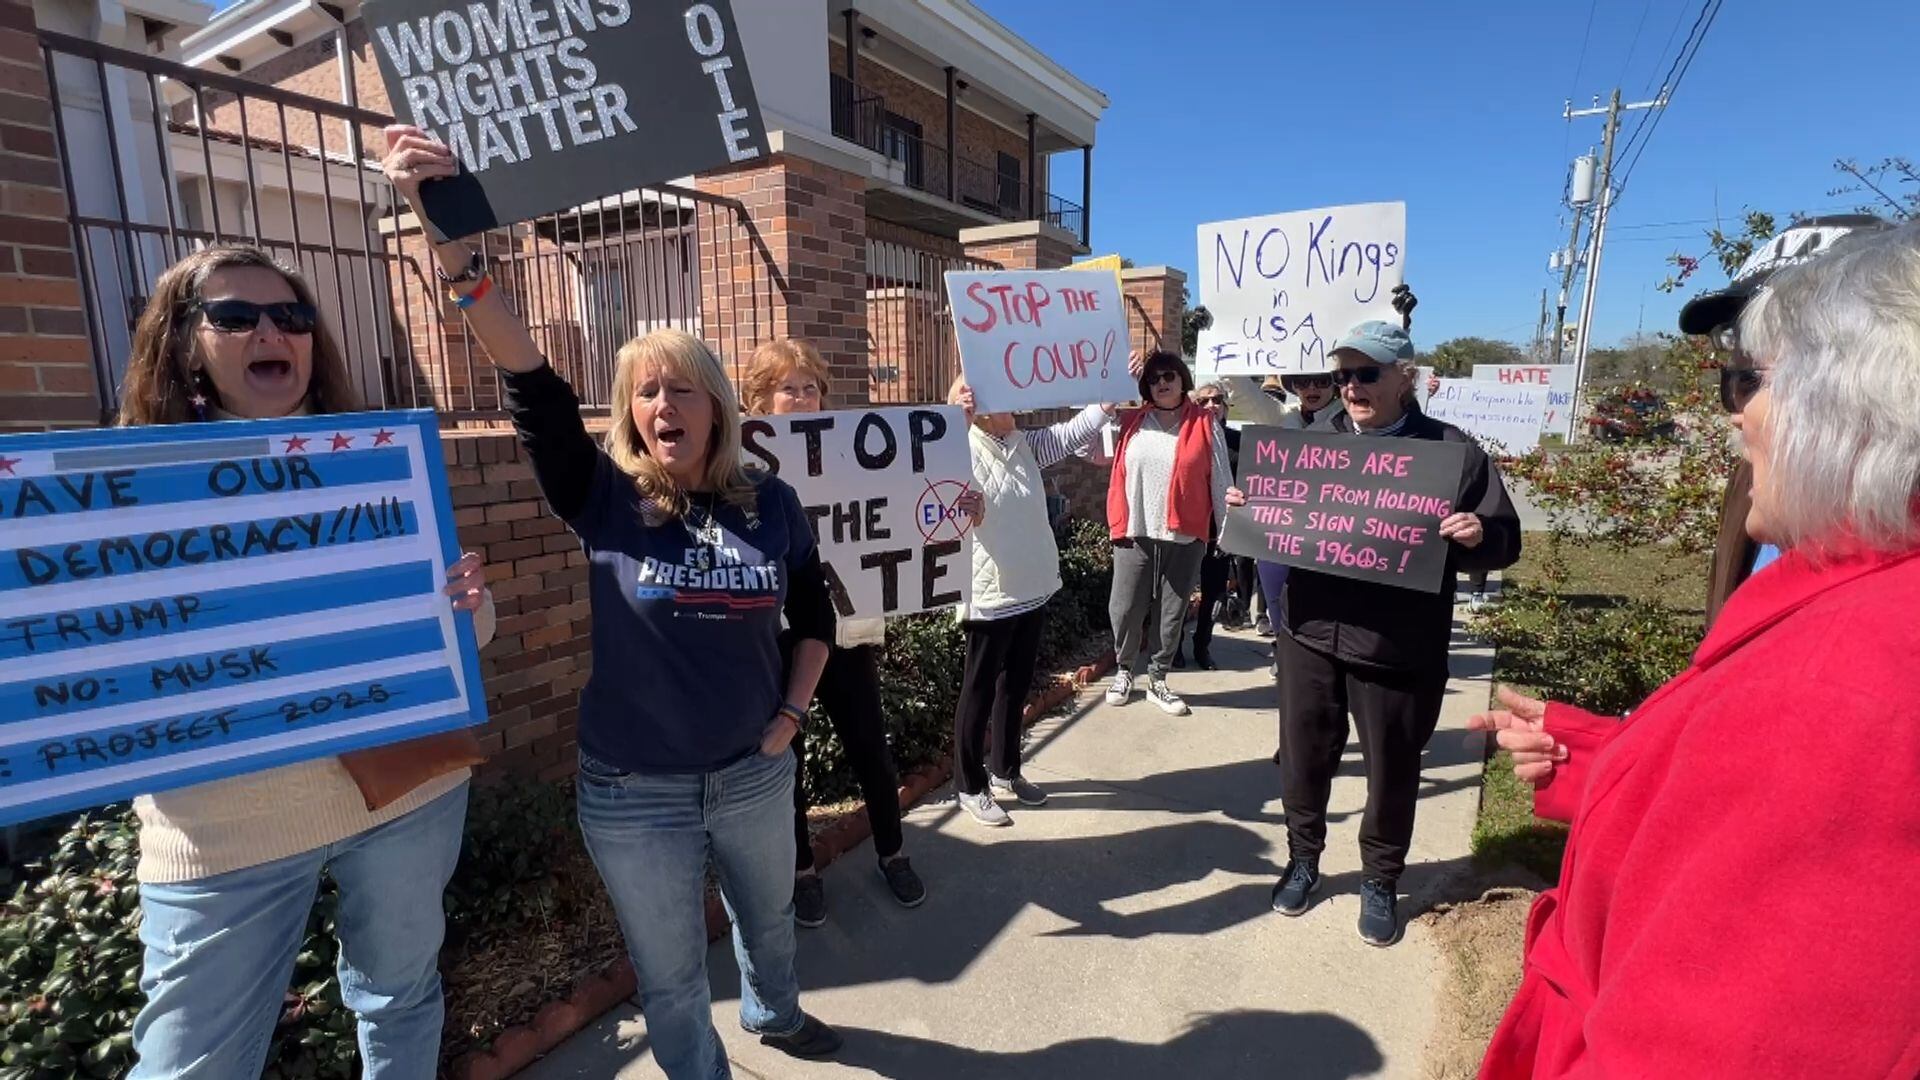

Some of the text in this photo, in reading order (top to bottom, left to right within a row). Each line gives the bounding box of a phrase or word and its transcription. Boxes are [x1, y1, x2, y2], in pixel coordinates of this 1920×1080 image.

[377, 0, 631, 76] WOMENS
[403, 38, 598, 130] RIGHTS
[684, 4, 759, 163] OTE
[424, 83, 638, 174] MATTER
[1216, 216, 1399, 303] NO Kings
[961, 282, 1101, 332] STOP THE
[1272, 288, 1289, 309] in
[1004, 329, 1116, 389] COUP!
[1210, 342, 1287, 372] Fire
[1498, 368, 1552, 384] HATE
[741, 409, 947, 478] STOP
[1295, 444, 1351, 469] ARMS
[1361, 452, 1413, 477] ARE
[0, 456, 322, 518] AVE OUR
[1246, 474, 1451, 518] TIRED FROM HOLDING
[803, 496, 891, 543] THE
[1251, 506, 1427, 545] THIS SIGN SINCE
[1265, 532, 1304, 555] THE
[8, 596, 201, 651] TRUMP
[34, 646, 278, 707] NO: MUSK
[37, 684, 390, 771] PROJECT 2025
